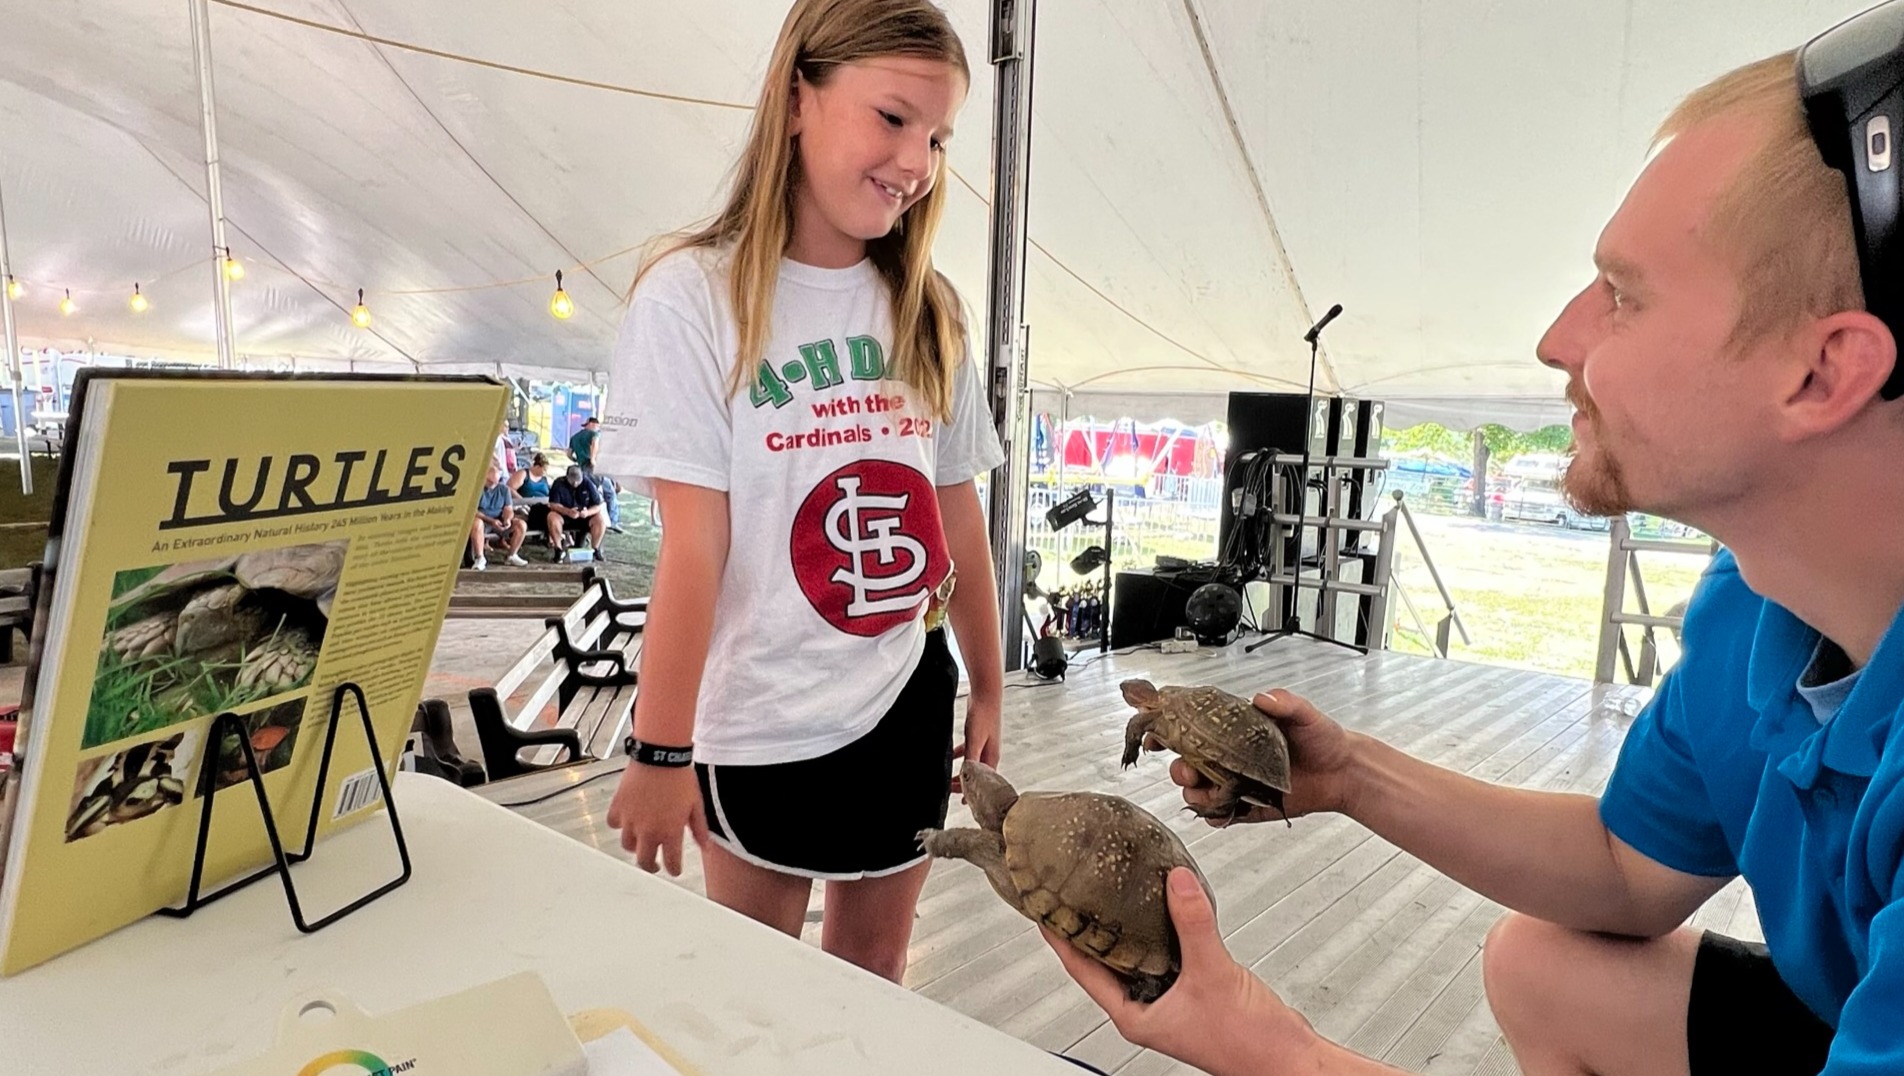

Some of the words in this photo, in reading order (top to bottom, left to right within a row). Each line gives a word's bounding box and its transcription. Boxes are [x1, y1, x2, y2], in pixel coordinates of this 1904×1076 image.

[811, 396, 861, 418] with
[865, 393, 905, 413] the
[765, 423, 873, 452] Cardinals
[160, 443, 466, 529] TURTLES
[151, 541, 169, 553] An
[173, 532, 252, 550] Extraordinary
[253, 525, 293, 540] Natural
[294, 521, 330, 534] History
[350, 514, 378, 526] Million
[380, 511, 402, 522] Years
[403, 510, 412, 519] in
[413, 508, 425, 518] the
[426, 505, 454, 515] Making
